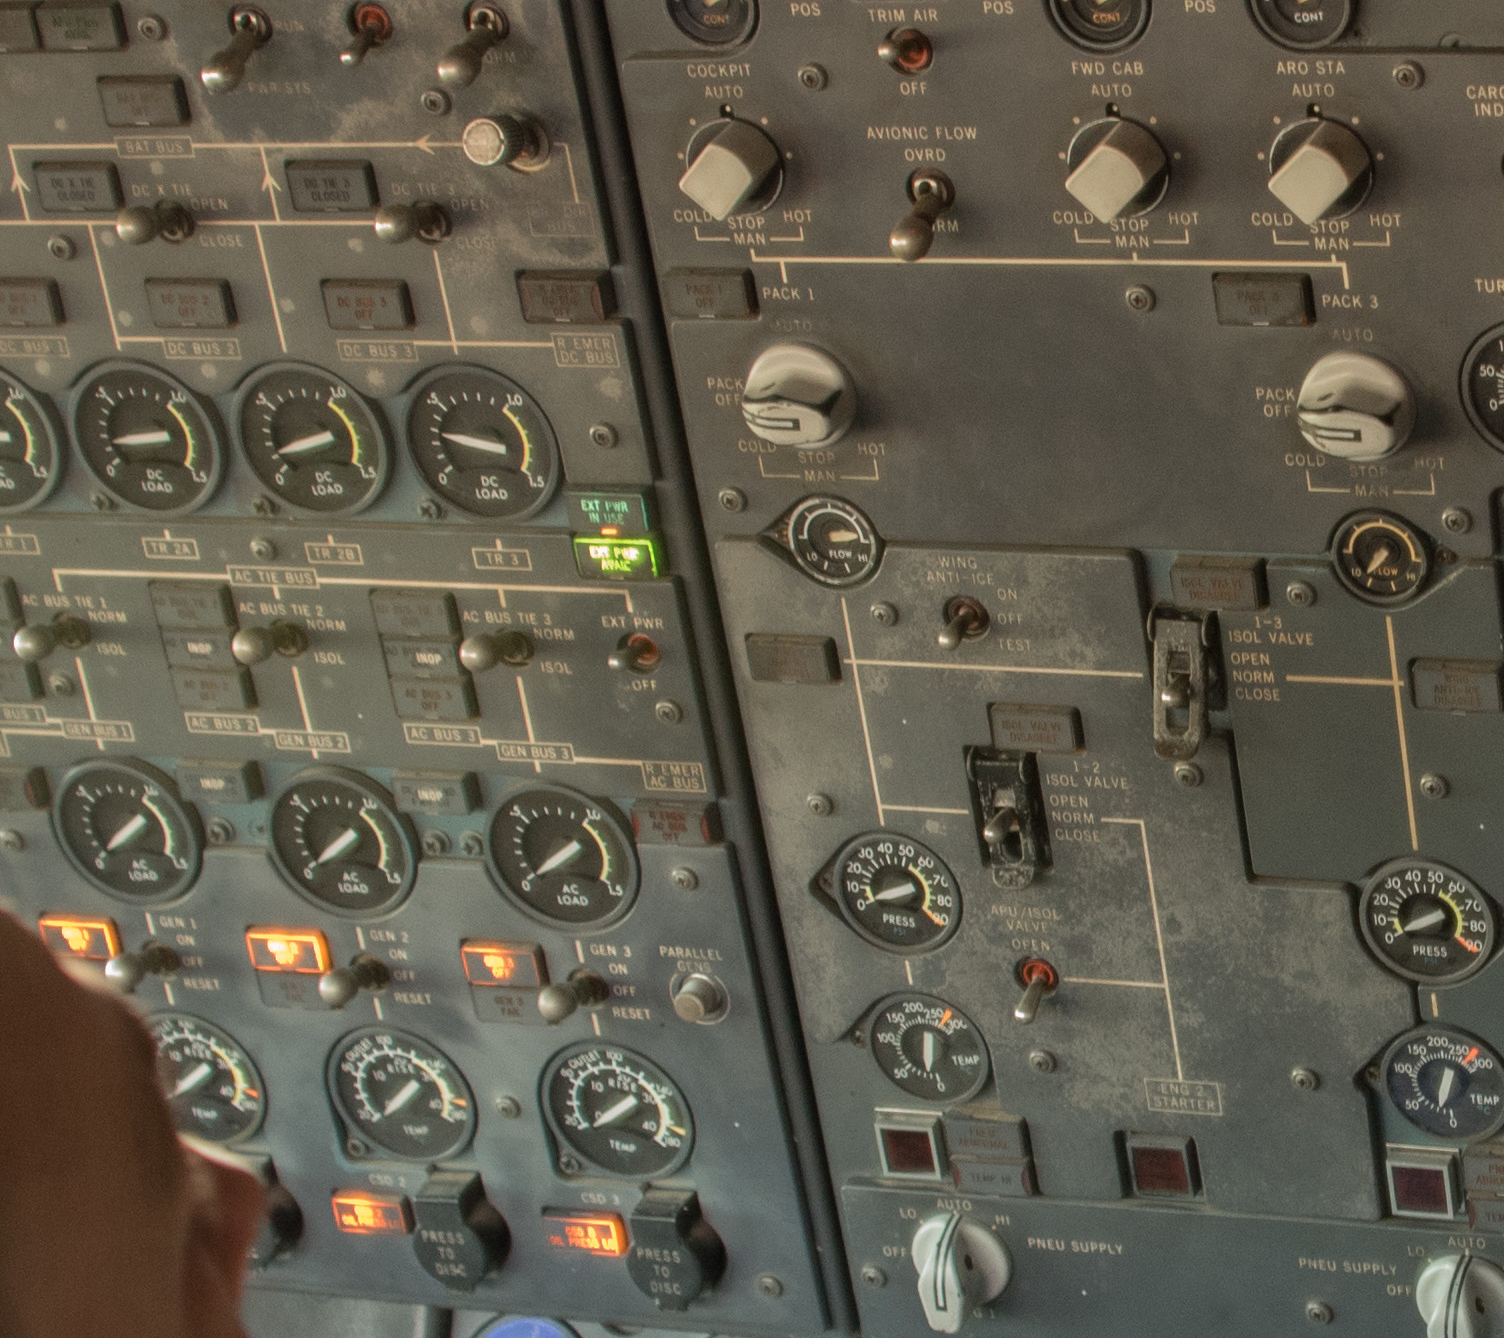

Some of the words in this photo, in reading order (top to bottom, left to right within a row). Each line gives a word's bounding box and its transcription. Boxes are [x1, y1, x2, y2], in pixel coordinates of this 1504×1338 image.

[791, 1, 821, 17] POS
[867, 8, 907, 24] TRIM
[910, 7, 939, 23] AIR
[686, 63, 753, 78] COCKPIT
[1276, 61, 1308, 76] ARO
[1315, 59, 1346, 76] STA
[867, 125, 928, 142] AVIONIC
[935, 125, 977, 141] FLOW
[904, 147, 946, 163] OVRD
[316, 473, 331, 484] DC
[311, 482, 342, 495] LOAD
[601, 615, 625, 629] EXT
[630, 615, 664, 631] PWR
[1228, 630, 1263, 645] ISOL
[1269, 630, 1314, 647] VALVE
[1230, 652, 1270, 667] OPEN
[1232, 669, 1275, 685] NORM
[1235, 687, 1281, 701] CLOSE
[612, 1005, 651, 1021] RESET
[1027, 1237, 1064, 1252] PNEU
[1069, 1239, 1124, 1257] SUPPLY
